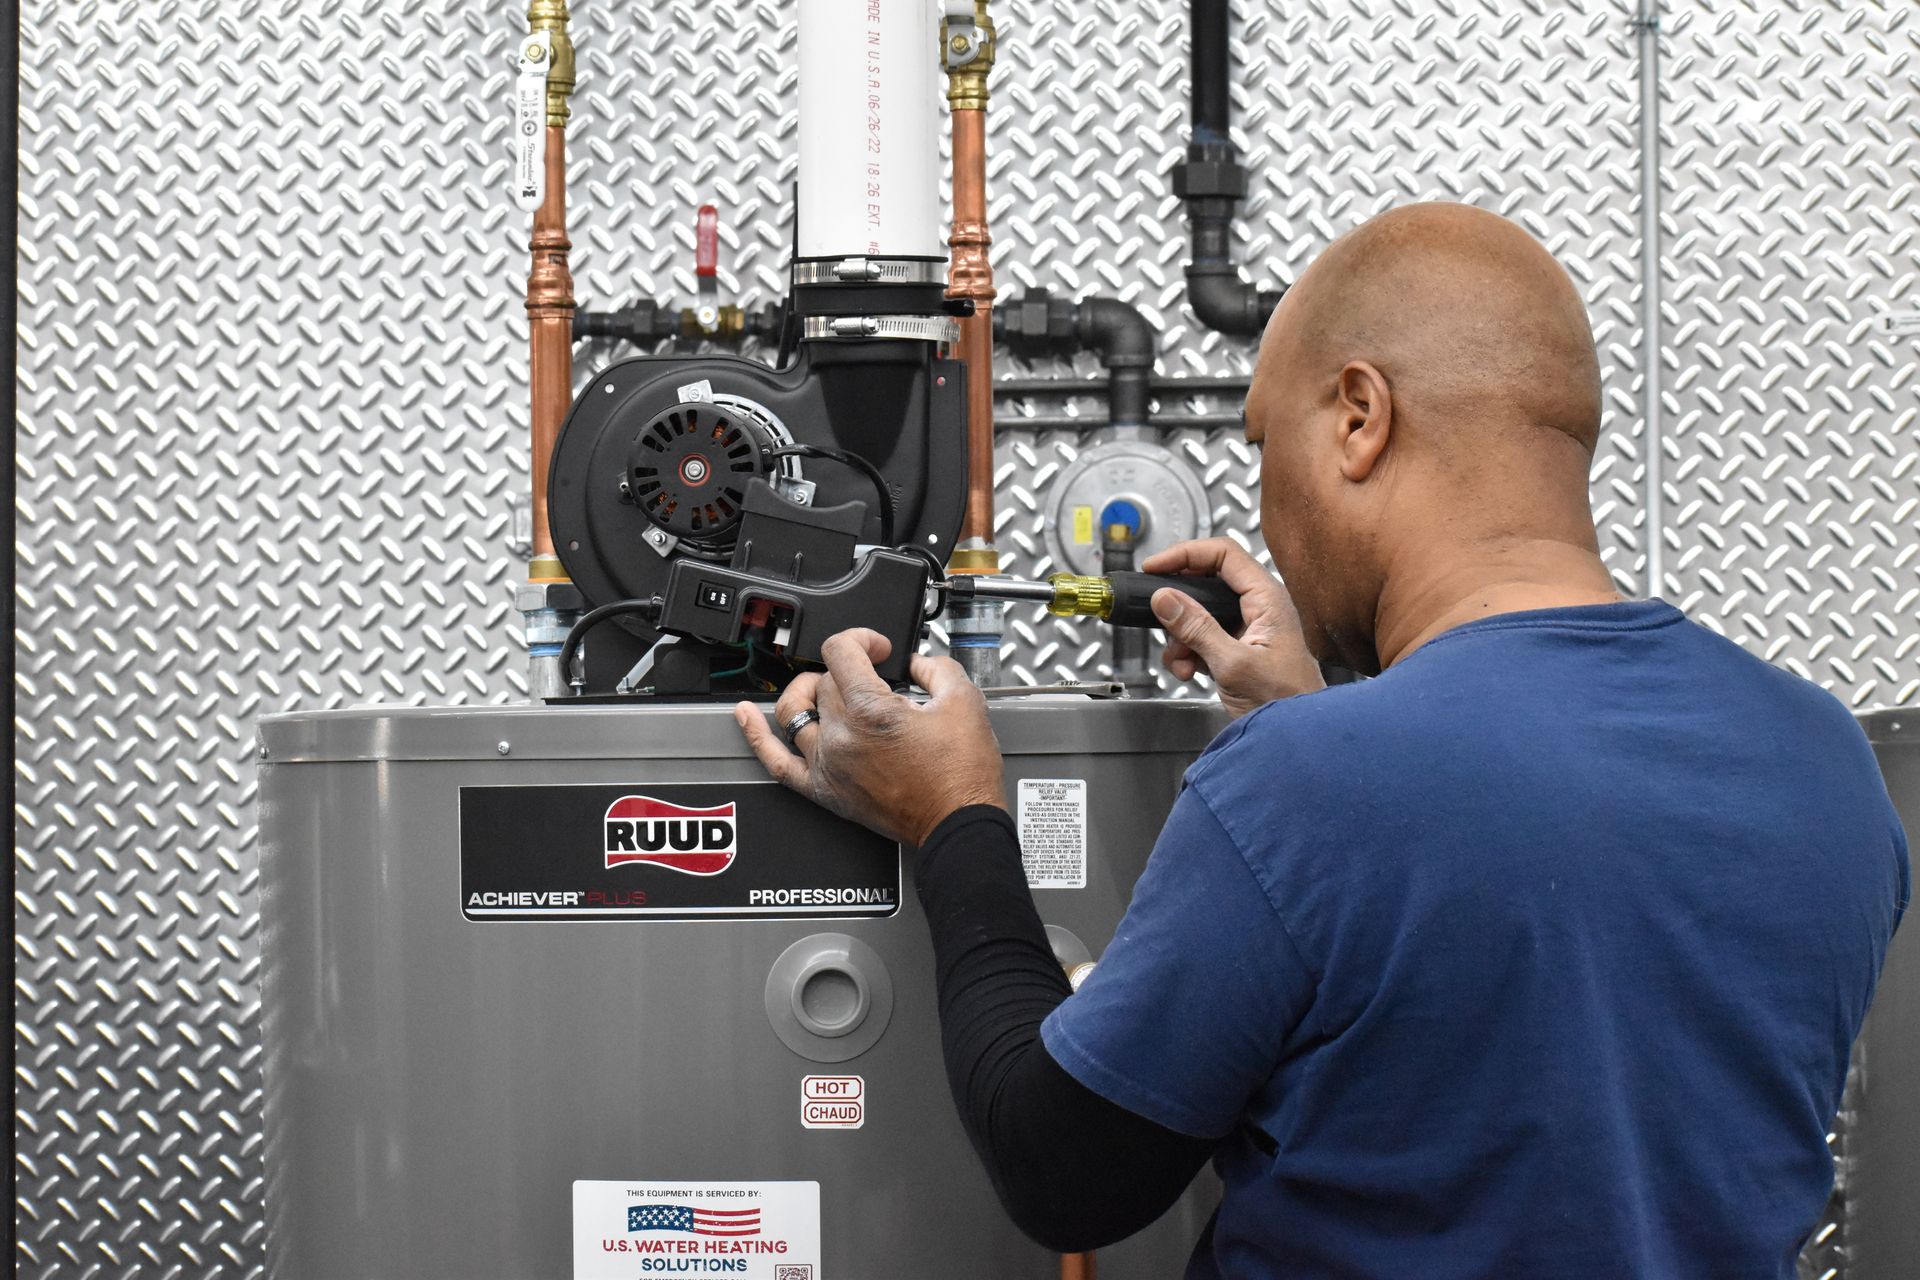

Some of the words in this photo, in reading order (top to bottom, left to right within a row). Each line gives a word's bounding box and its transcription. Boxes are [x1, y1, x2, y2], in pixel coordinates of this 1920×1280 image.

[867, 0, 880, 23] ADE
[867, 30, 880, 46] IN
[868, 163, 880, 197] 18:26
[868, 204, 880, 231] EXT.
[710, 592, 716, 601] ON
[606, 820, 734, 851] RUUD
[587, 891, 647, 905] PLUS
[816, 1082, 850, 1094] HOT
[810, 1106, 858, 1119] CHAUD
[646, 1190, 692, 1198] EQUIPMENT
[602, 1240, 632, 1252] U.S.
[635, 1240, 699, 1254] WATER
[704, 1240, 788, 1254] HEATING
[642, 1258, 748, 1272] SOLUTIONS
